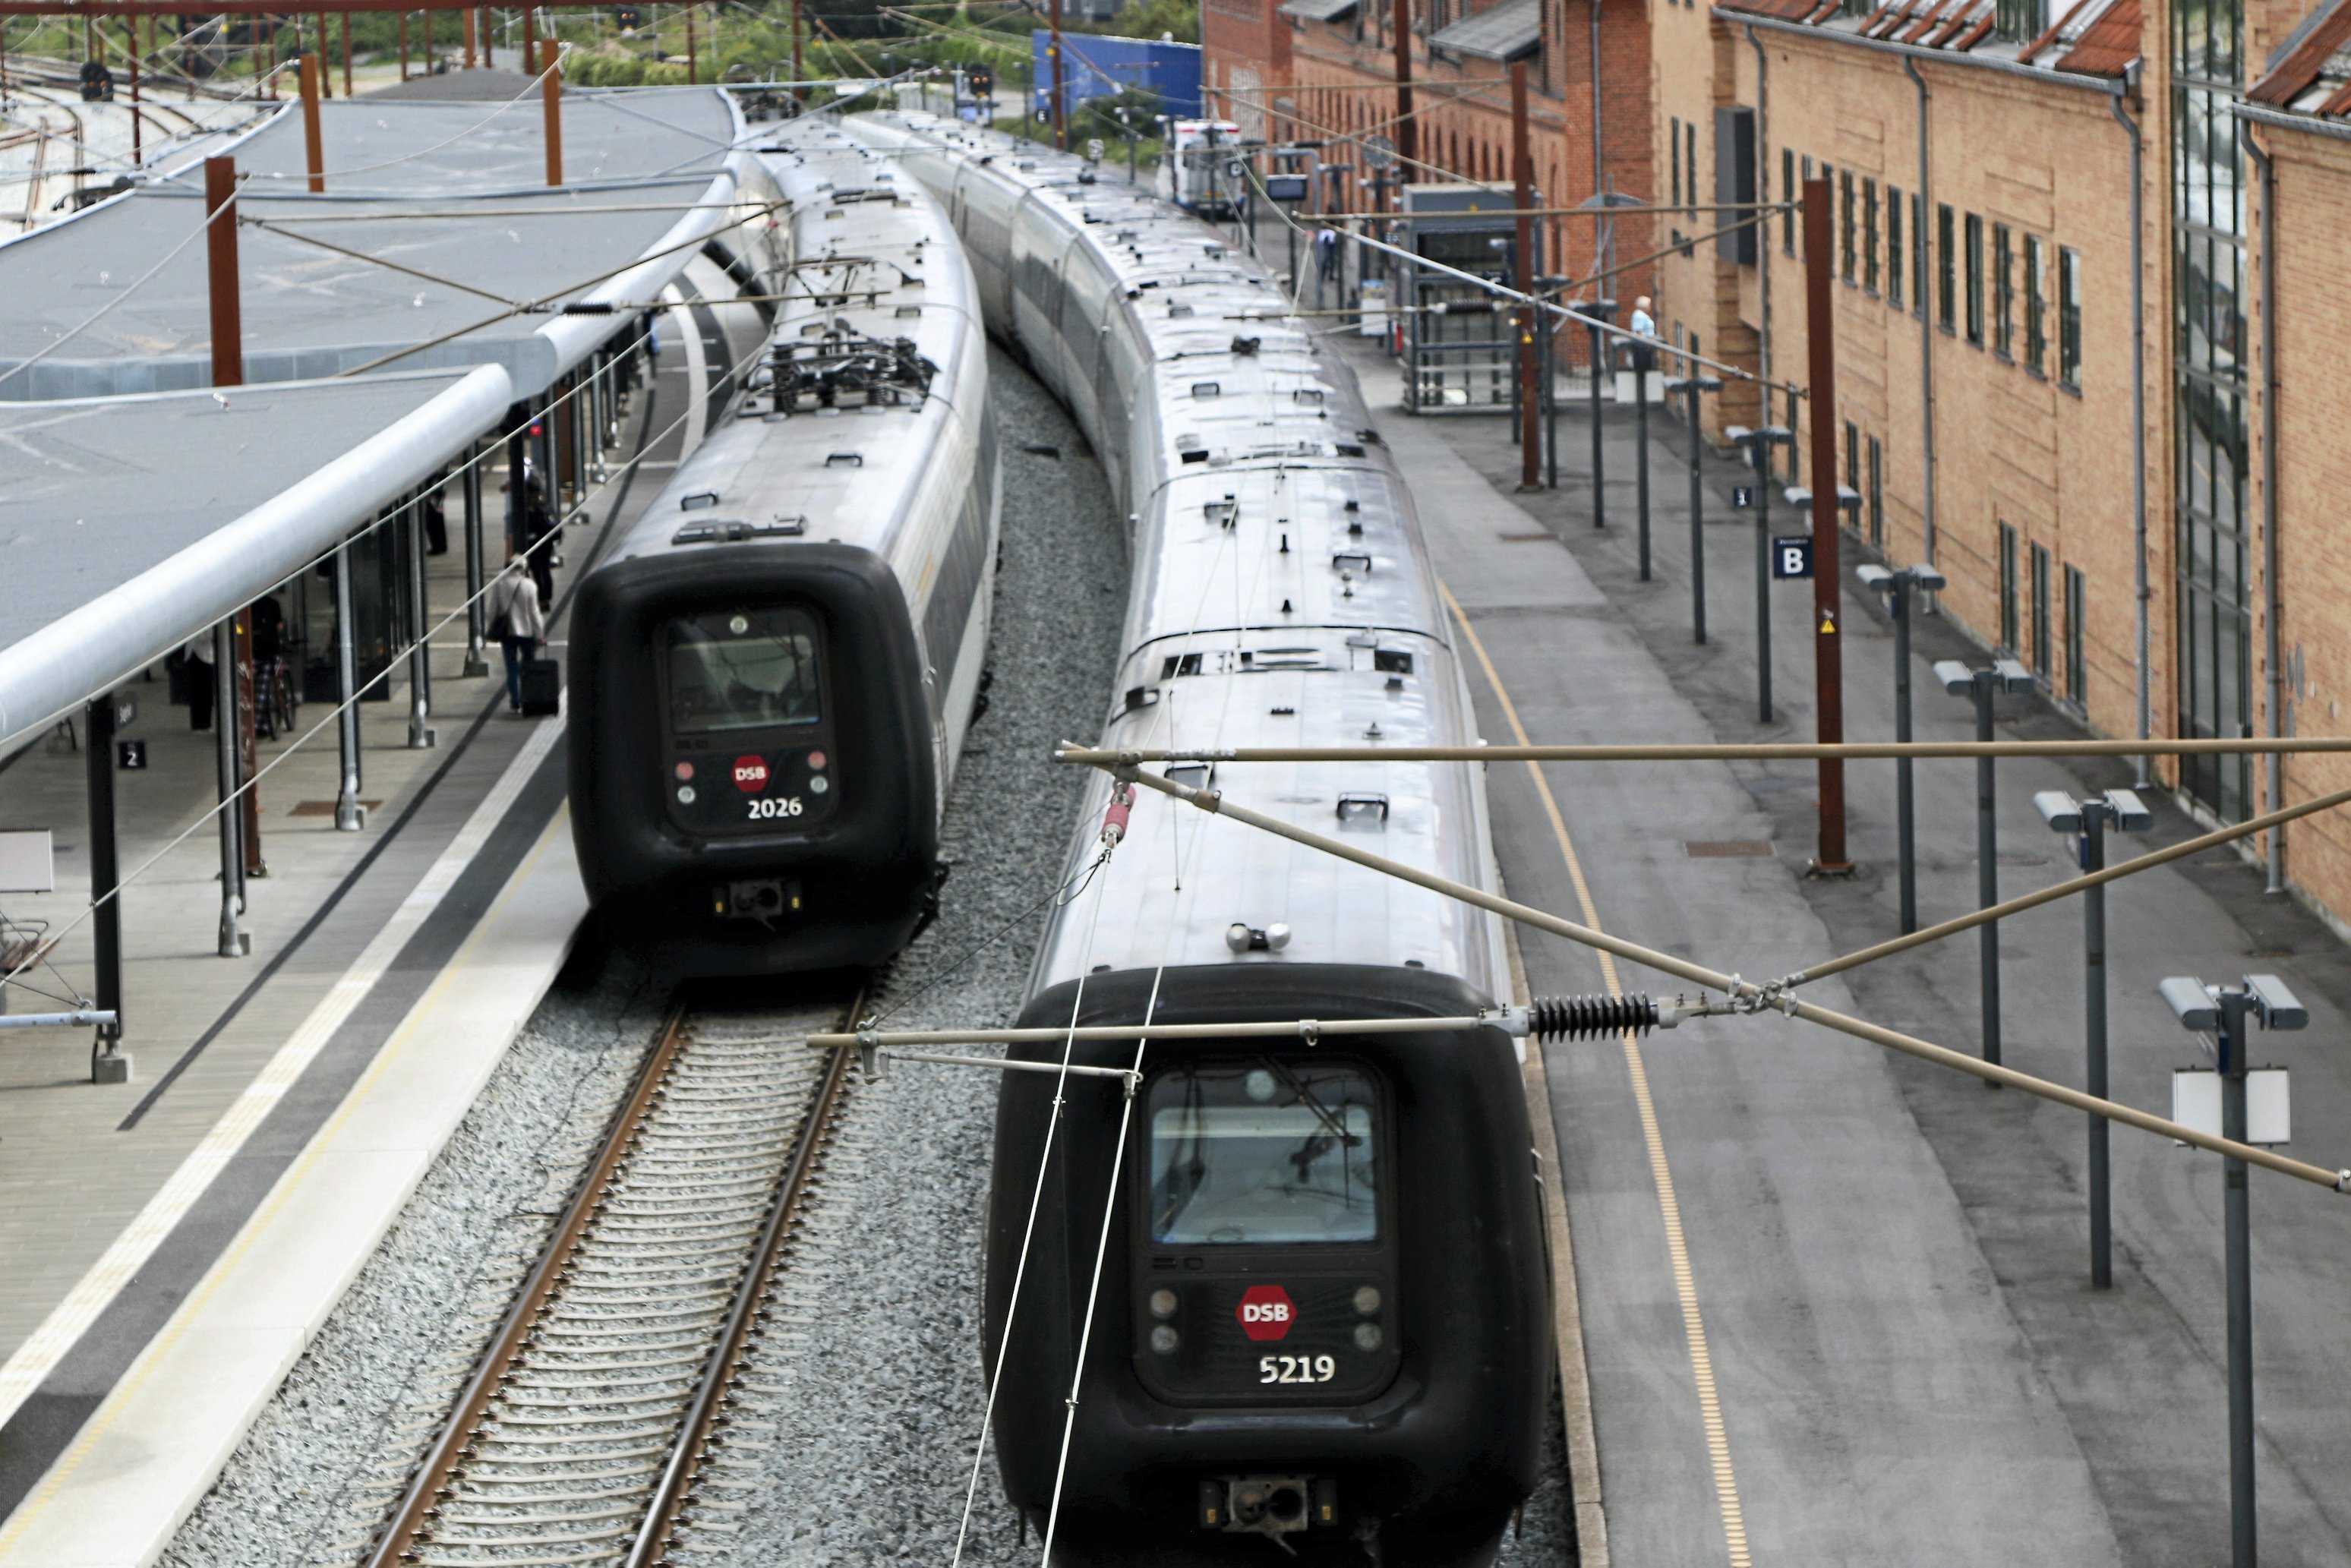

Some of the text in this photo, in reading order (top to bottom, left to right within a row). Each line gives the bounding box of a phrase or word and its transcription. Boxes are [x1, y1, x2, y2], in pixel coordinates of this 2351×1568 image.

[1784, 547, 1804, 574] B
[127, 751, 137, 766] 2
[734, 766, 766, 781] DSB
[748, 797, 803, 819] 2026
[1243, 1304, 1289, 1322] DSB
[1260, 1355, 1335, 1383] 5219
